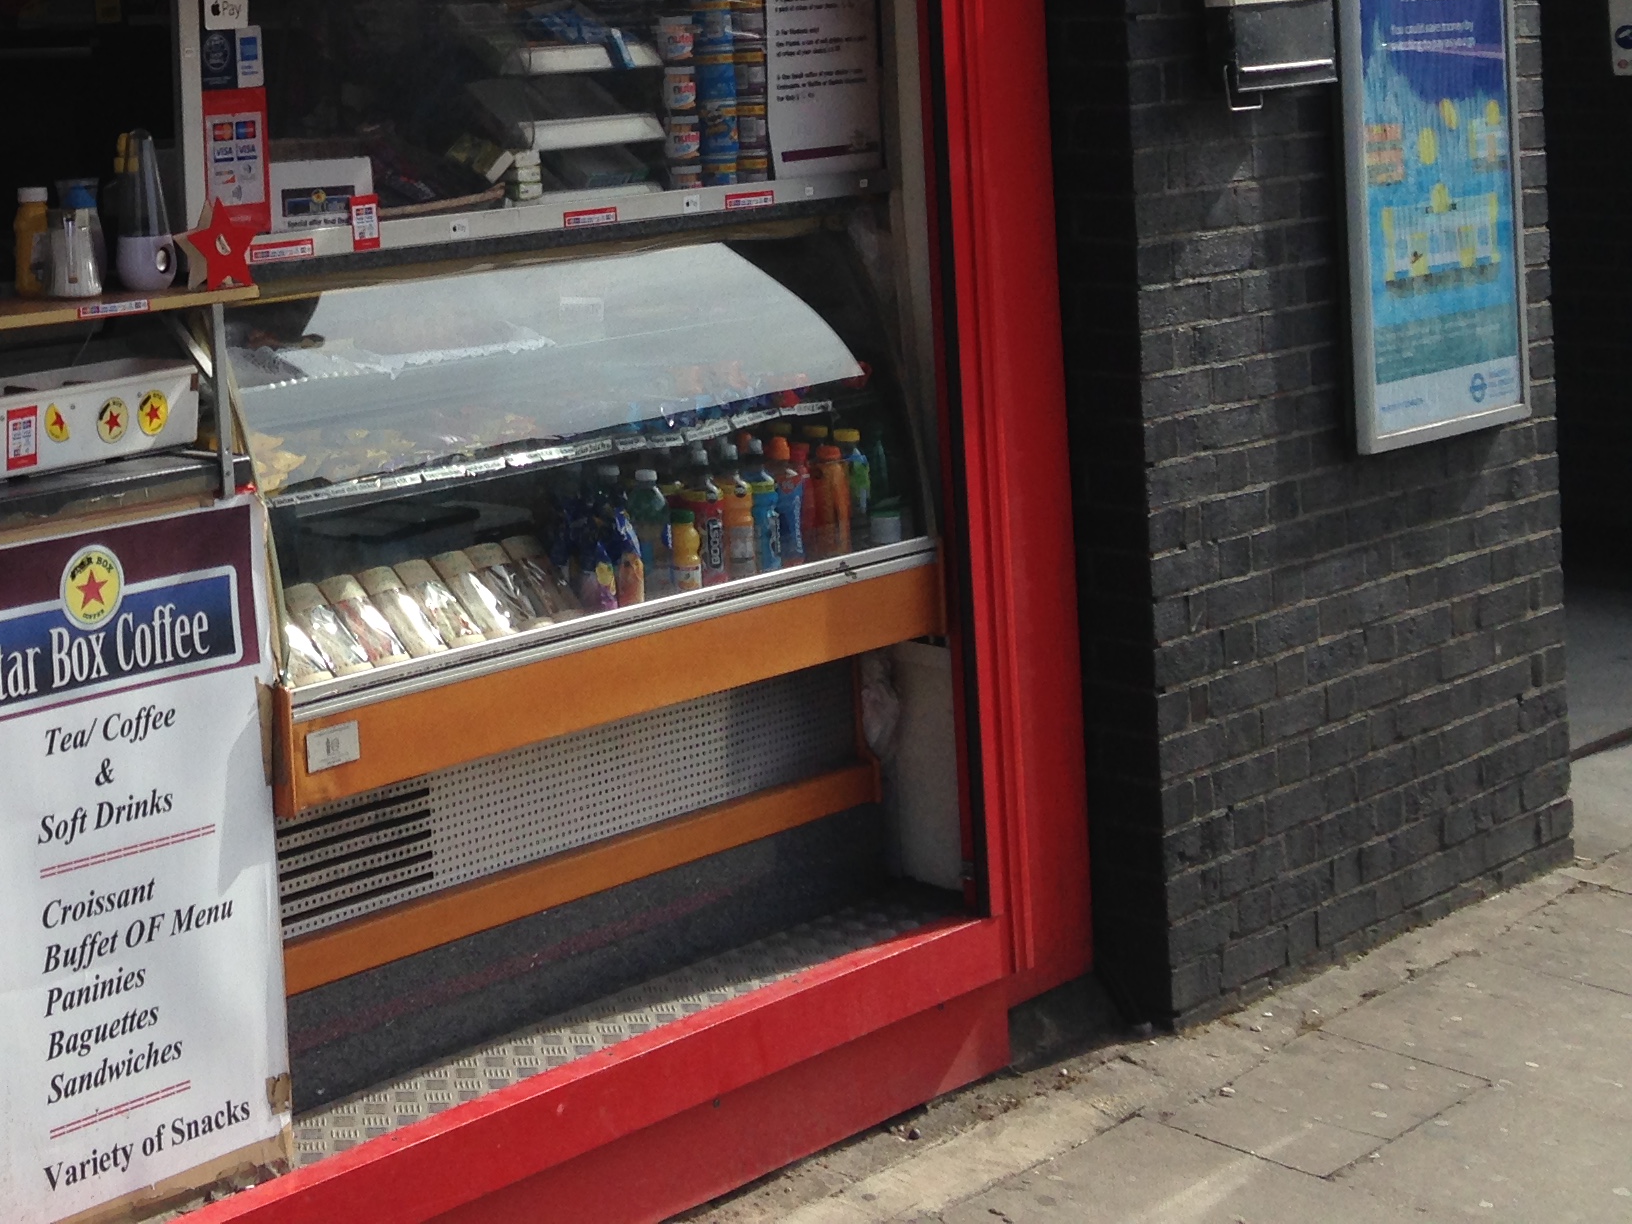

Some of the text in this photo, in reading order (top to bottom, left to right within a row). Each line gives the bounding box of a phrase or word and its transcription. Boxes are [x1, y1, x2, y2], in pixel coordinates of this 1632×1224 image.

[221, 1, 242, 19] Pay
[95, 556, 115, 574] BOX
[49, 626, 107, 689] Box
[116, 603, 211, 672] Coffee
[44, 704, 176, 757] Tea/ Coffee
[94, 757, 115, 787] &
[37, 788, 174, 845] Soft Drinks
[41, 877, 155, 929] Croissant
[41, 899, 234, 974] Buffet OF Menu
[43, 966, 146, 1018] Paninies
[45, 1006, 160, 1061] Baguettes
[47, 1040, 183, 1106] Sandwiches
[43, 1099, 252, 1192] Variety of Snacks
